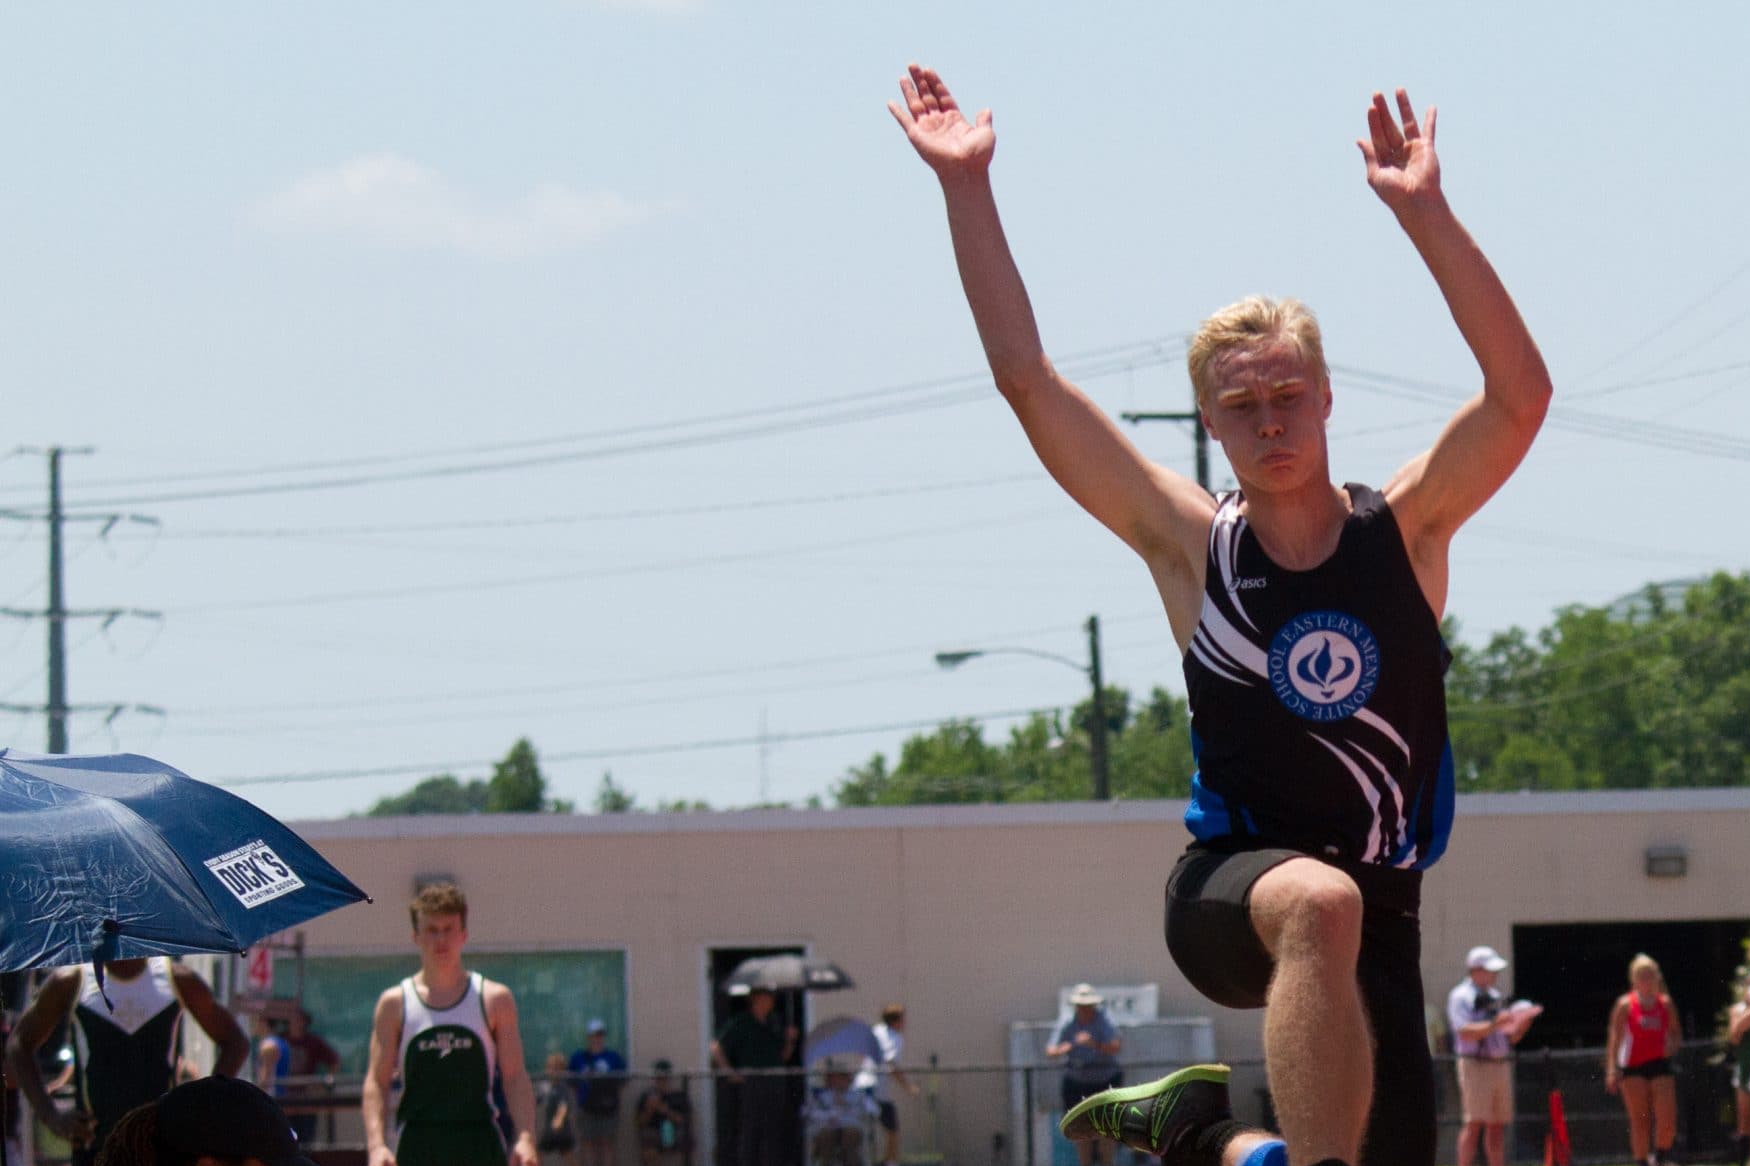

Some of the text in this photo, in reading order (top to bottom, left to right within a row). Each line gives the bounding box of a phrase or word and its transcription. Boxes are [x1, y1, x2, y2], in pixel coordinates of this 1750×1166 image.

[1270, 614, 1377, 719] EASTERN MENNONITE SCHOOL
[217, 851, 289, 896] DICK'S
[249, 948, 268, 985] 4
